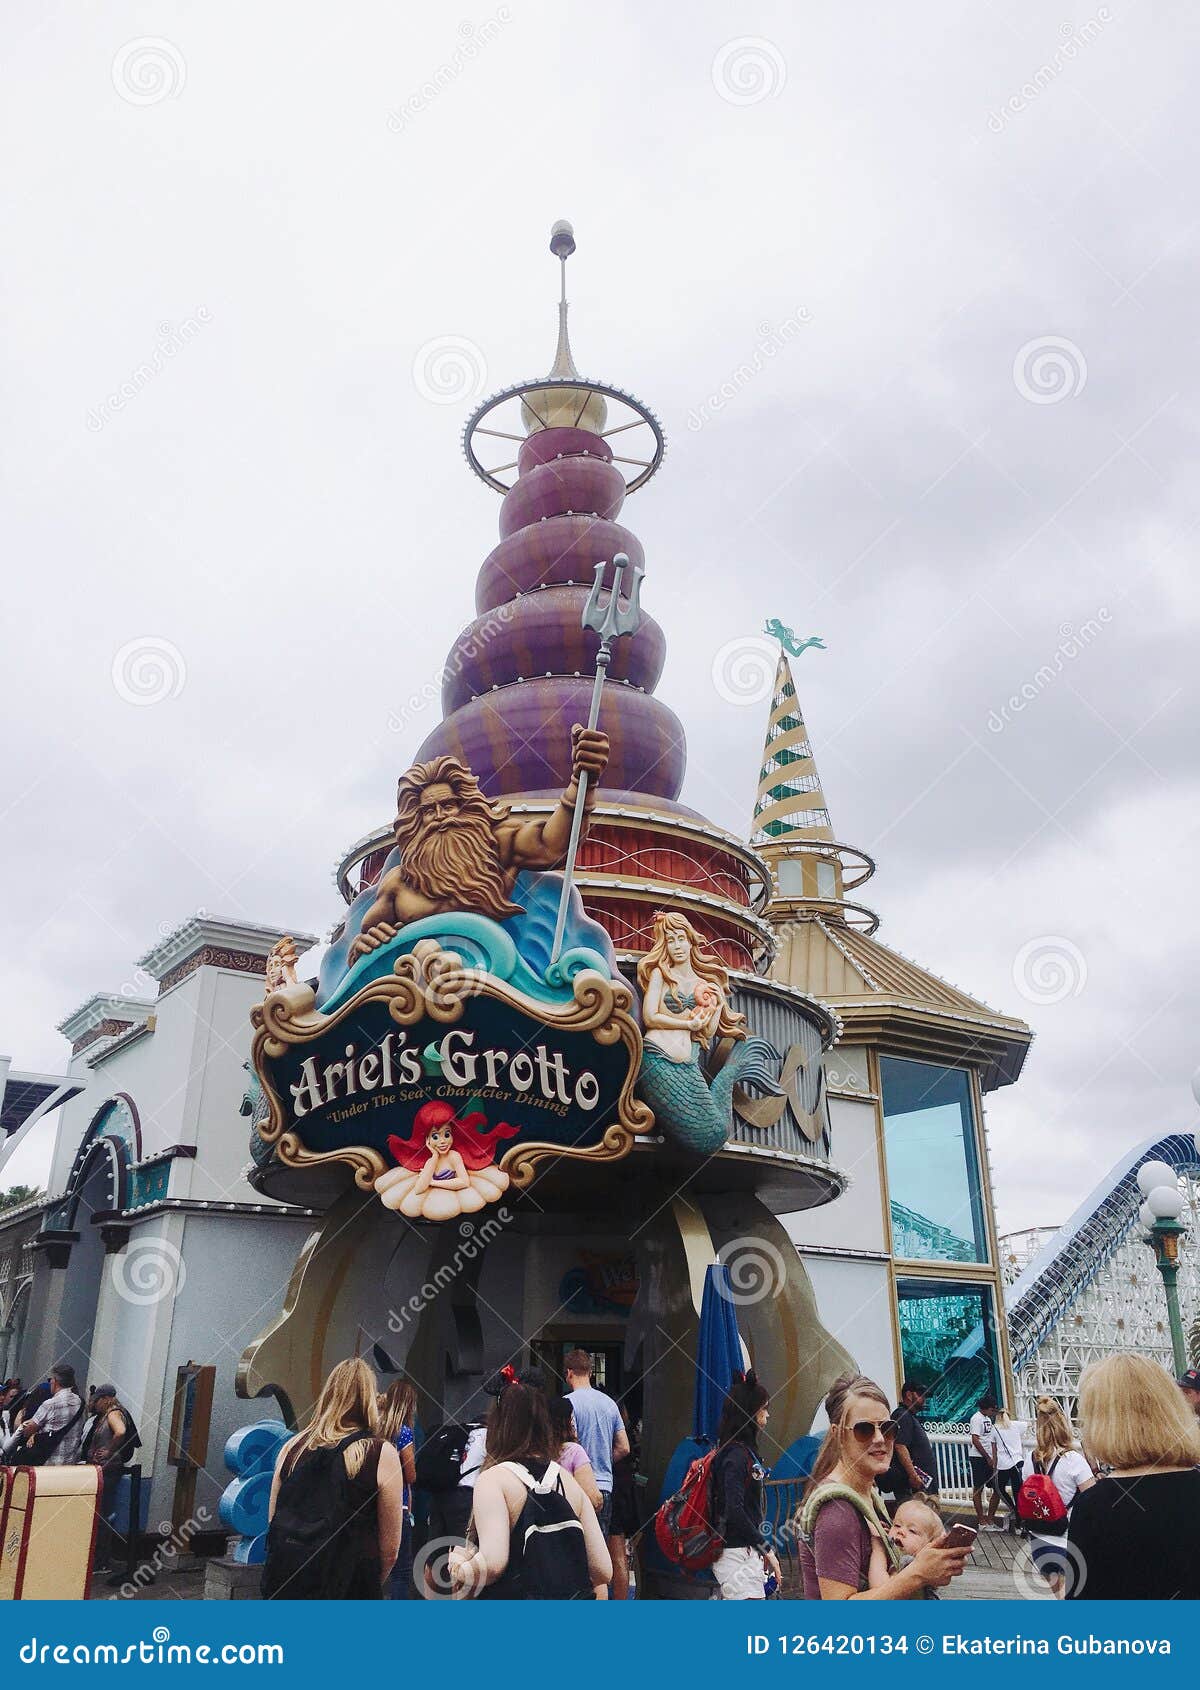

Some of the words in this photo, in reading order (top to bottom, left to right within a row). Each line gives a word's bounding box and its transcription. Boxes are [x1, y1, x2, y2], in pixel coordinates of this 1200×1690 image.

[290, 1031, 422, 1117] Ariel's
[440, 1030, 600, 1111] Grotto
[371, 1093, 396, 1108] The
[436, 1084, 512, 1100] Character
[515, 1092, 570, 1117] Dining
